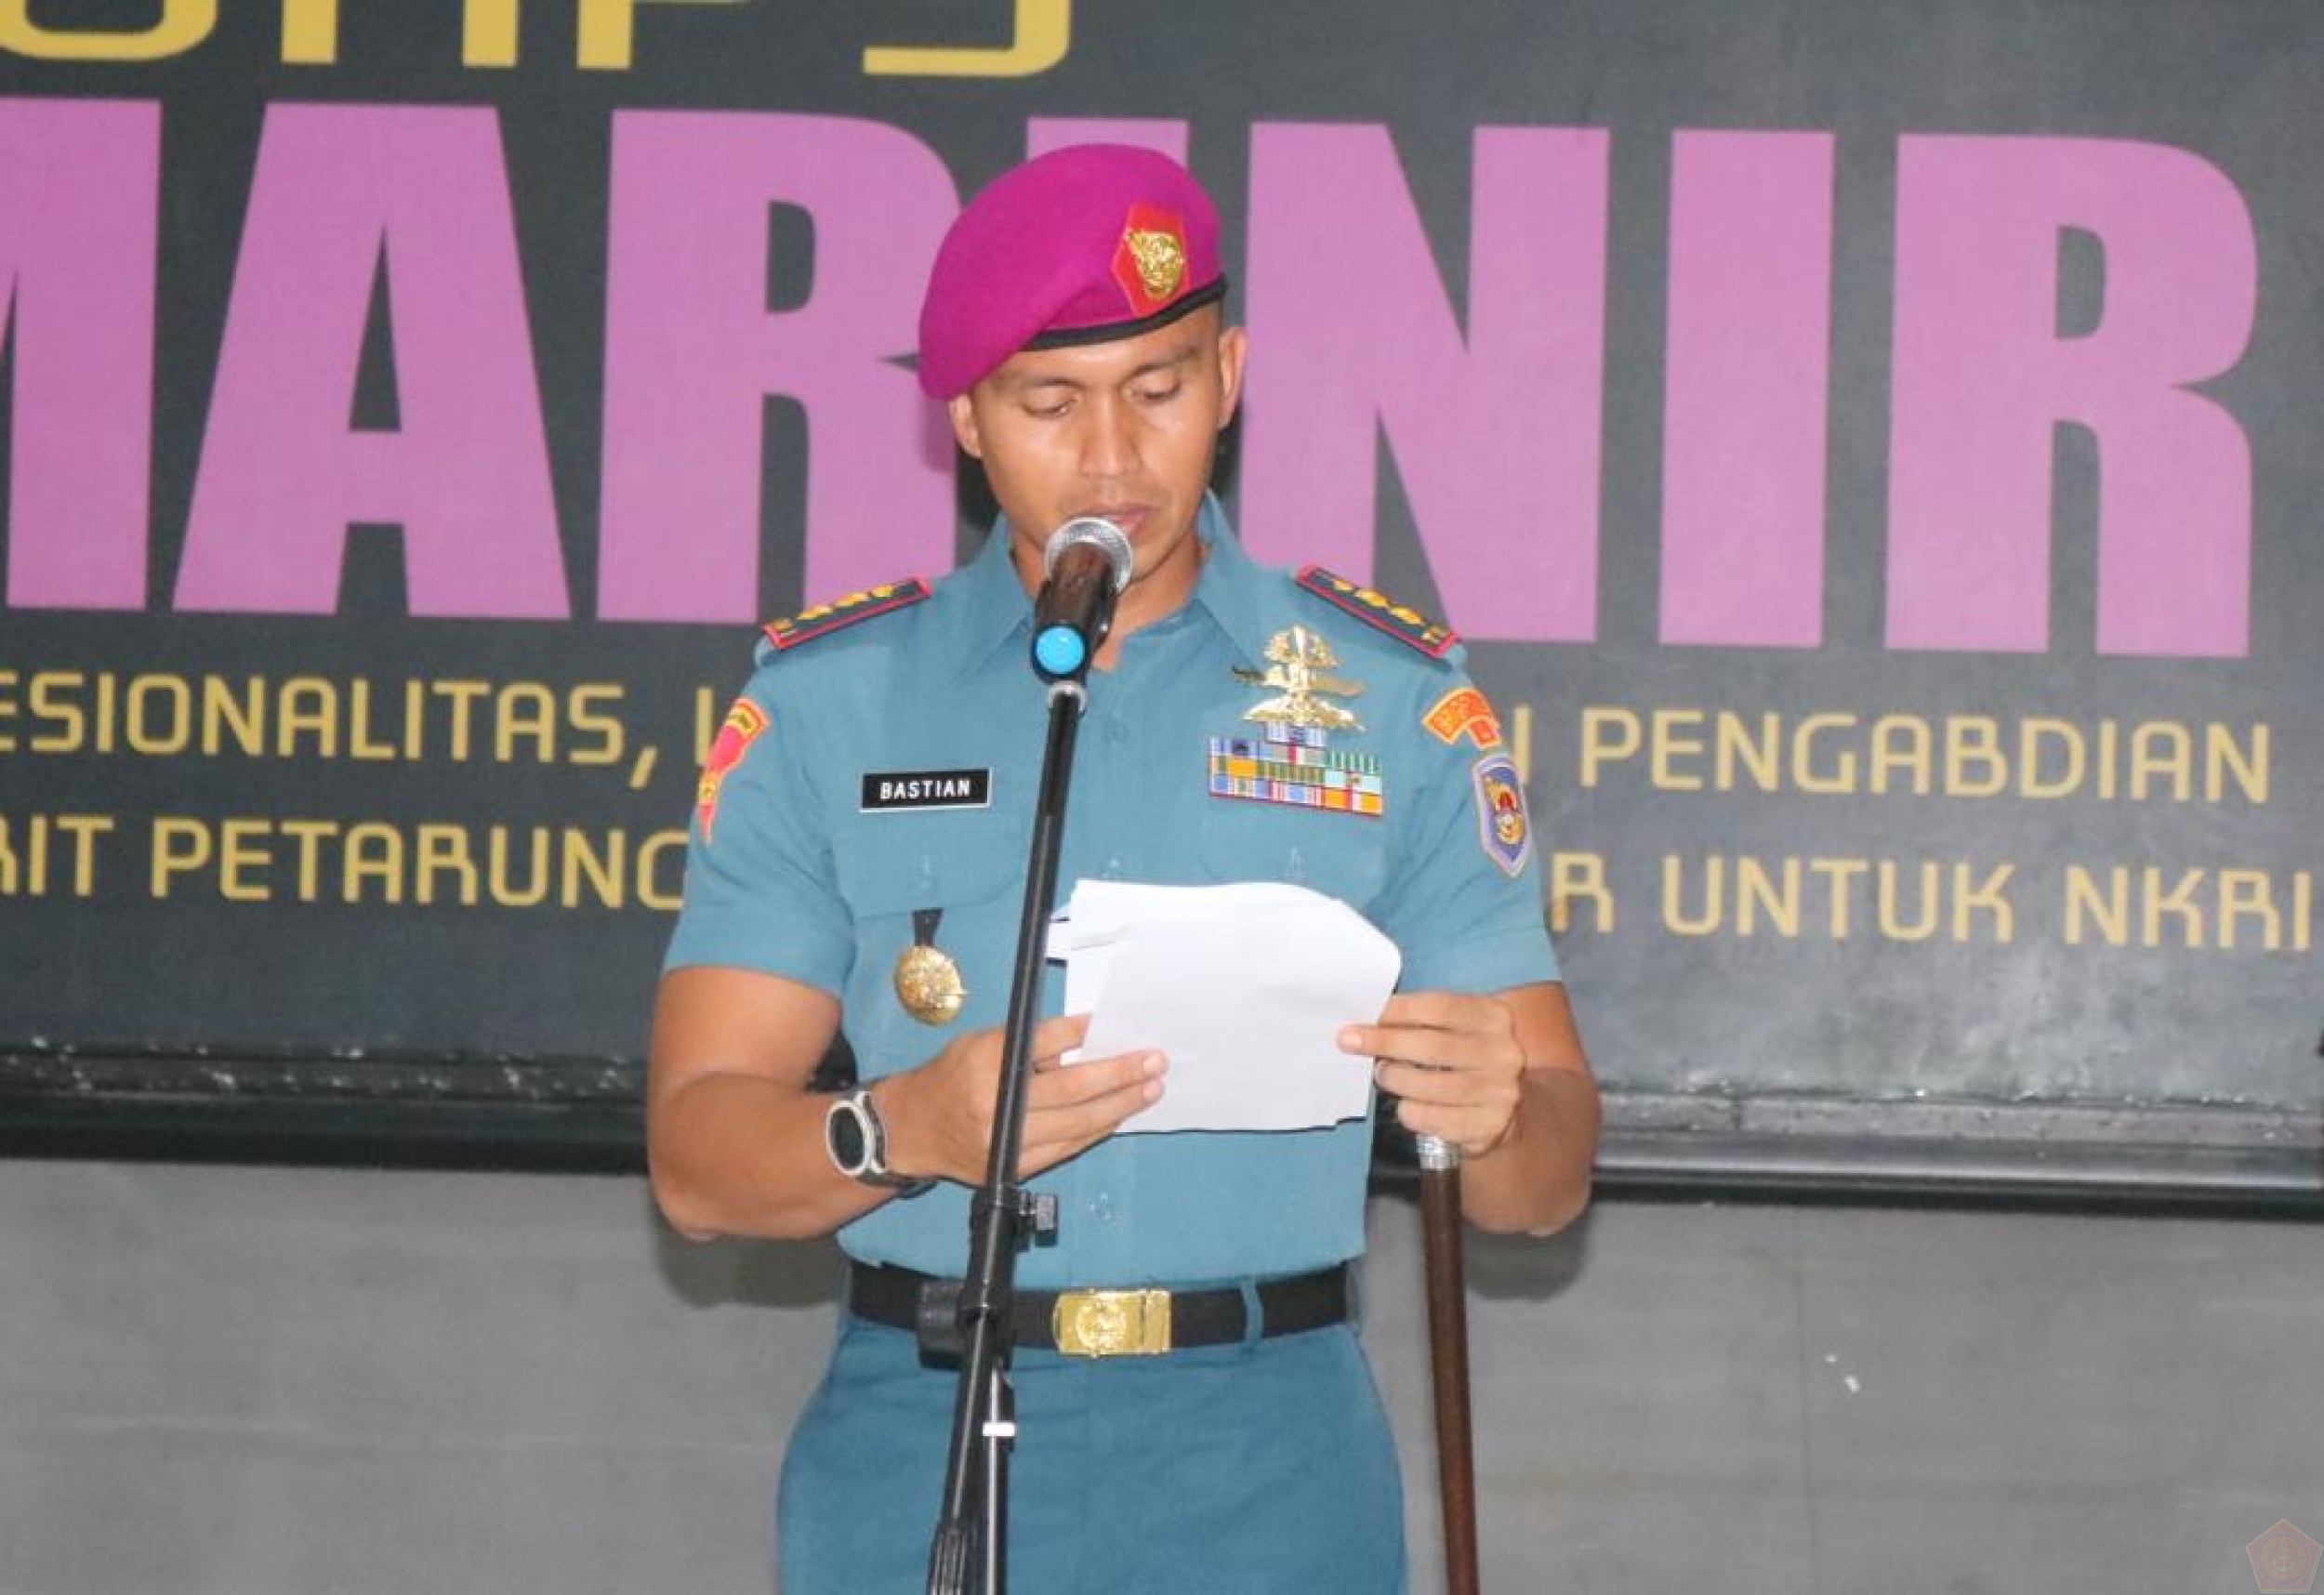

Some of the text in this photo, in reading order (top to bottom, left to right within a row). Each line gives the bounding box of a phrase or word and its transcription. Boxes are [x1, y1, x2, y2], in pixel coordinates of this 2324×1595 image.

[0, 97, 2262, 658] ARNIR
[879, 778, 971, 799] BASTIAN
[1578, 706, 2271, 803] PENGABDIAN
[1662, 855, 2015, 942] UNTUK
[2066, 866, 2312, 952] NKRI
